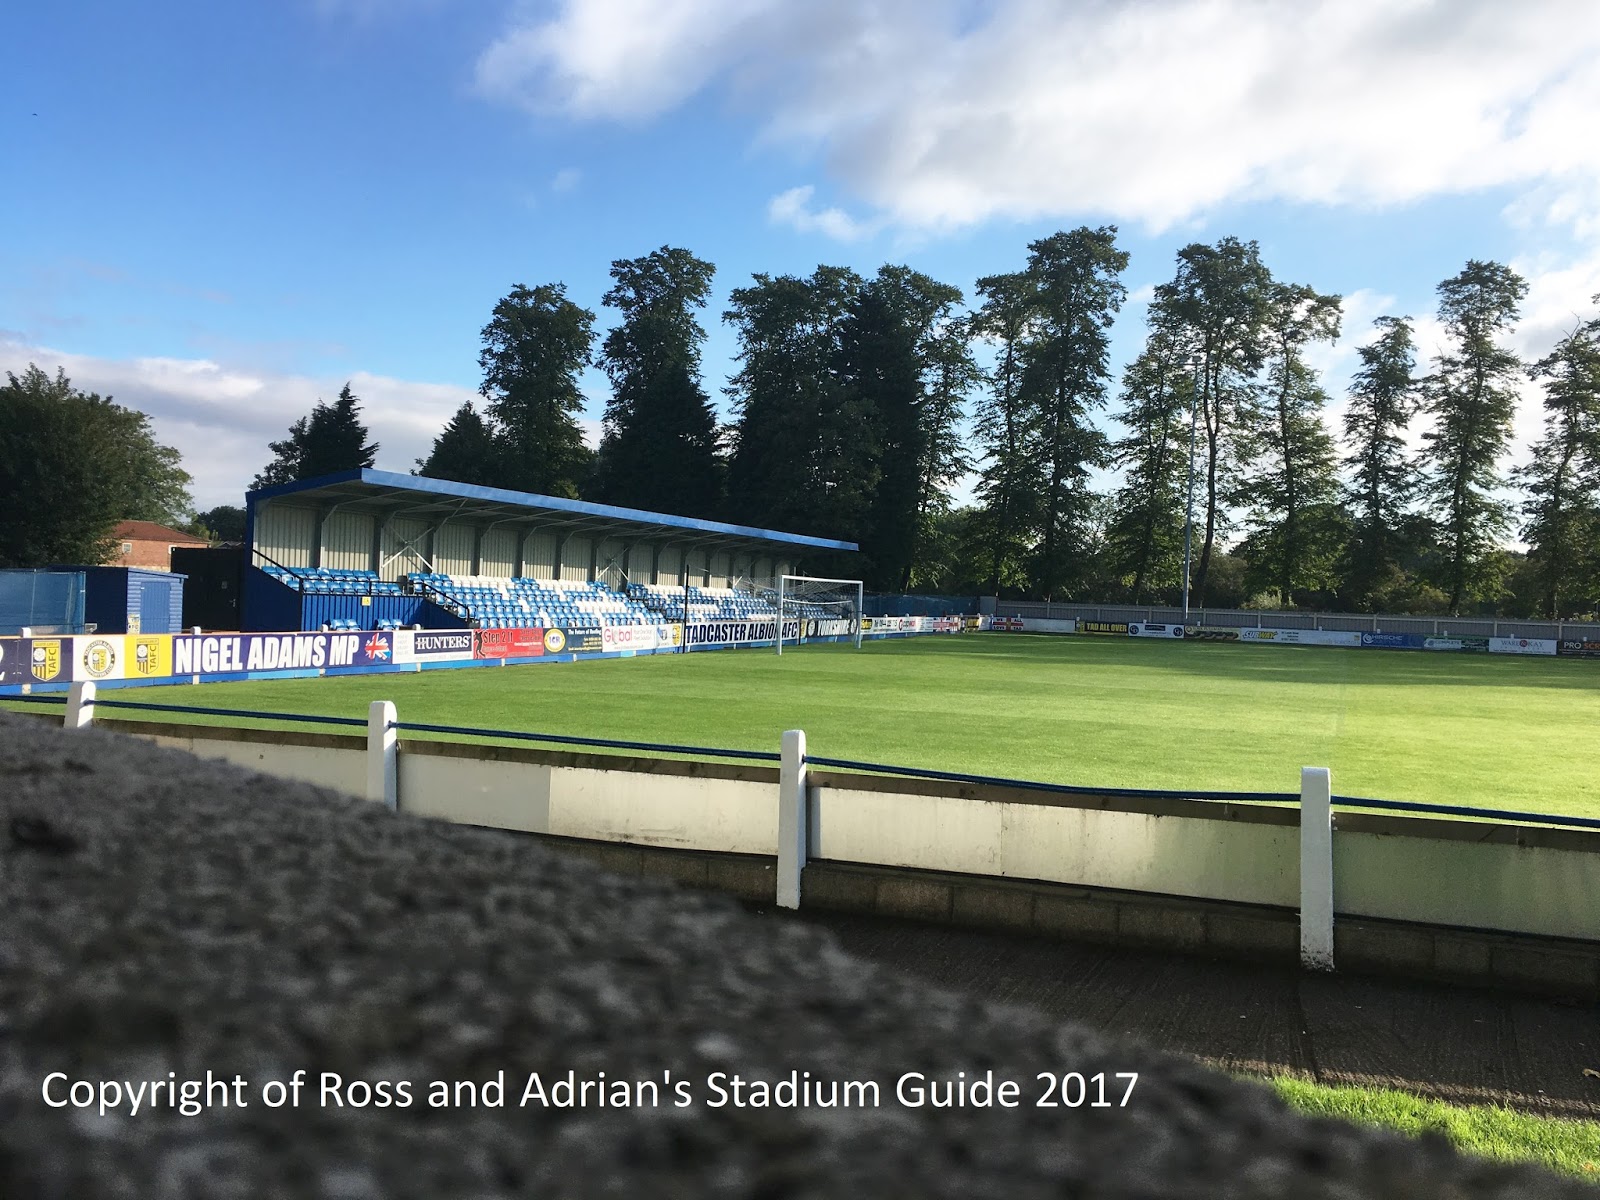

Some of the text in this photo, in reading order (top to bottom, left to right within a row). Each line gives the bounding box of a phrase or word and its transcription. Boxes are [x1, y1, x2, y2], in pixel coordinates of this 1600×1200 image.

[686, 623, 746, 644] TADCASTER
[782, 621, 798, 638] AFC
[1087, 622, 1127, 632] TAD ALL OVER
[1243, 630, 1279, 639] SUBWAY
[415, 635, 471, 650] HUNTERS
[483, 631, 500, 644] Step
[501, 630, 507, 643] 2
[1564, 641, 1582, 649] PRO
[48, 648, 57, 674] TAFC
[148, 645, 157, 669] TAFC
[175, 637, 243, 674] NIGEL
[247, 635, 327, 670] ADAMS
[328, 635, 360, 666] MP
